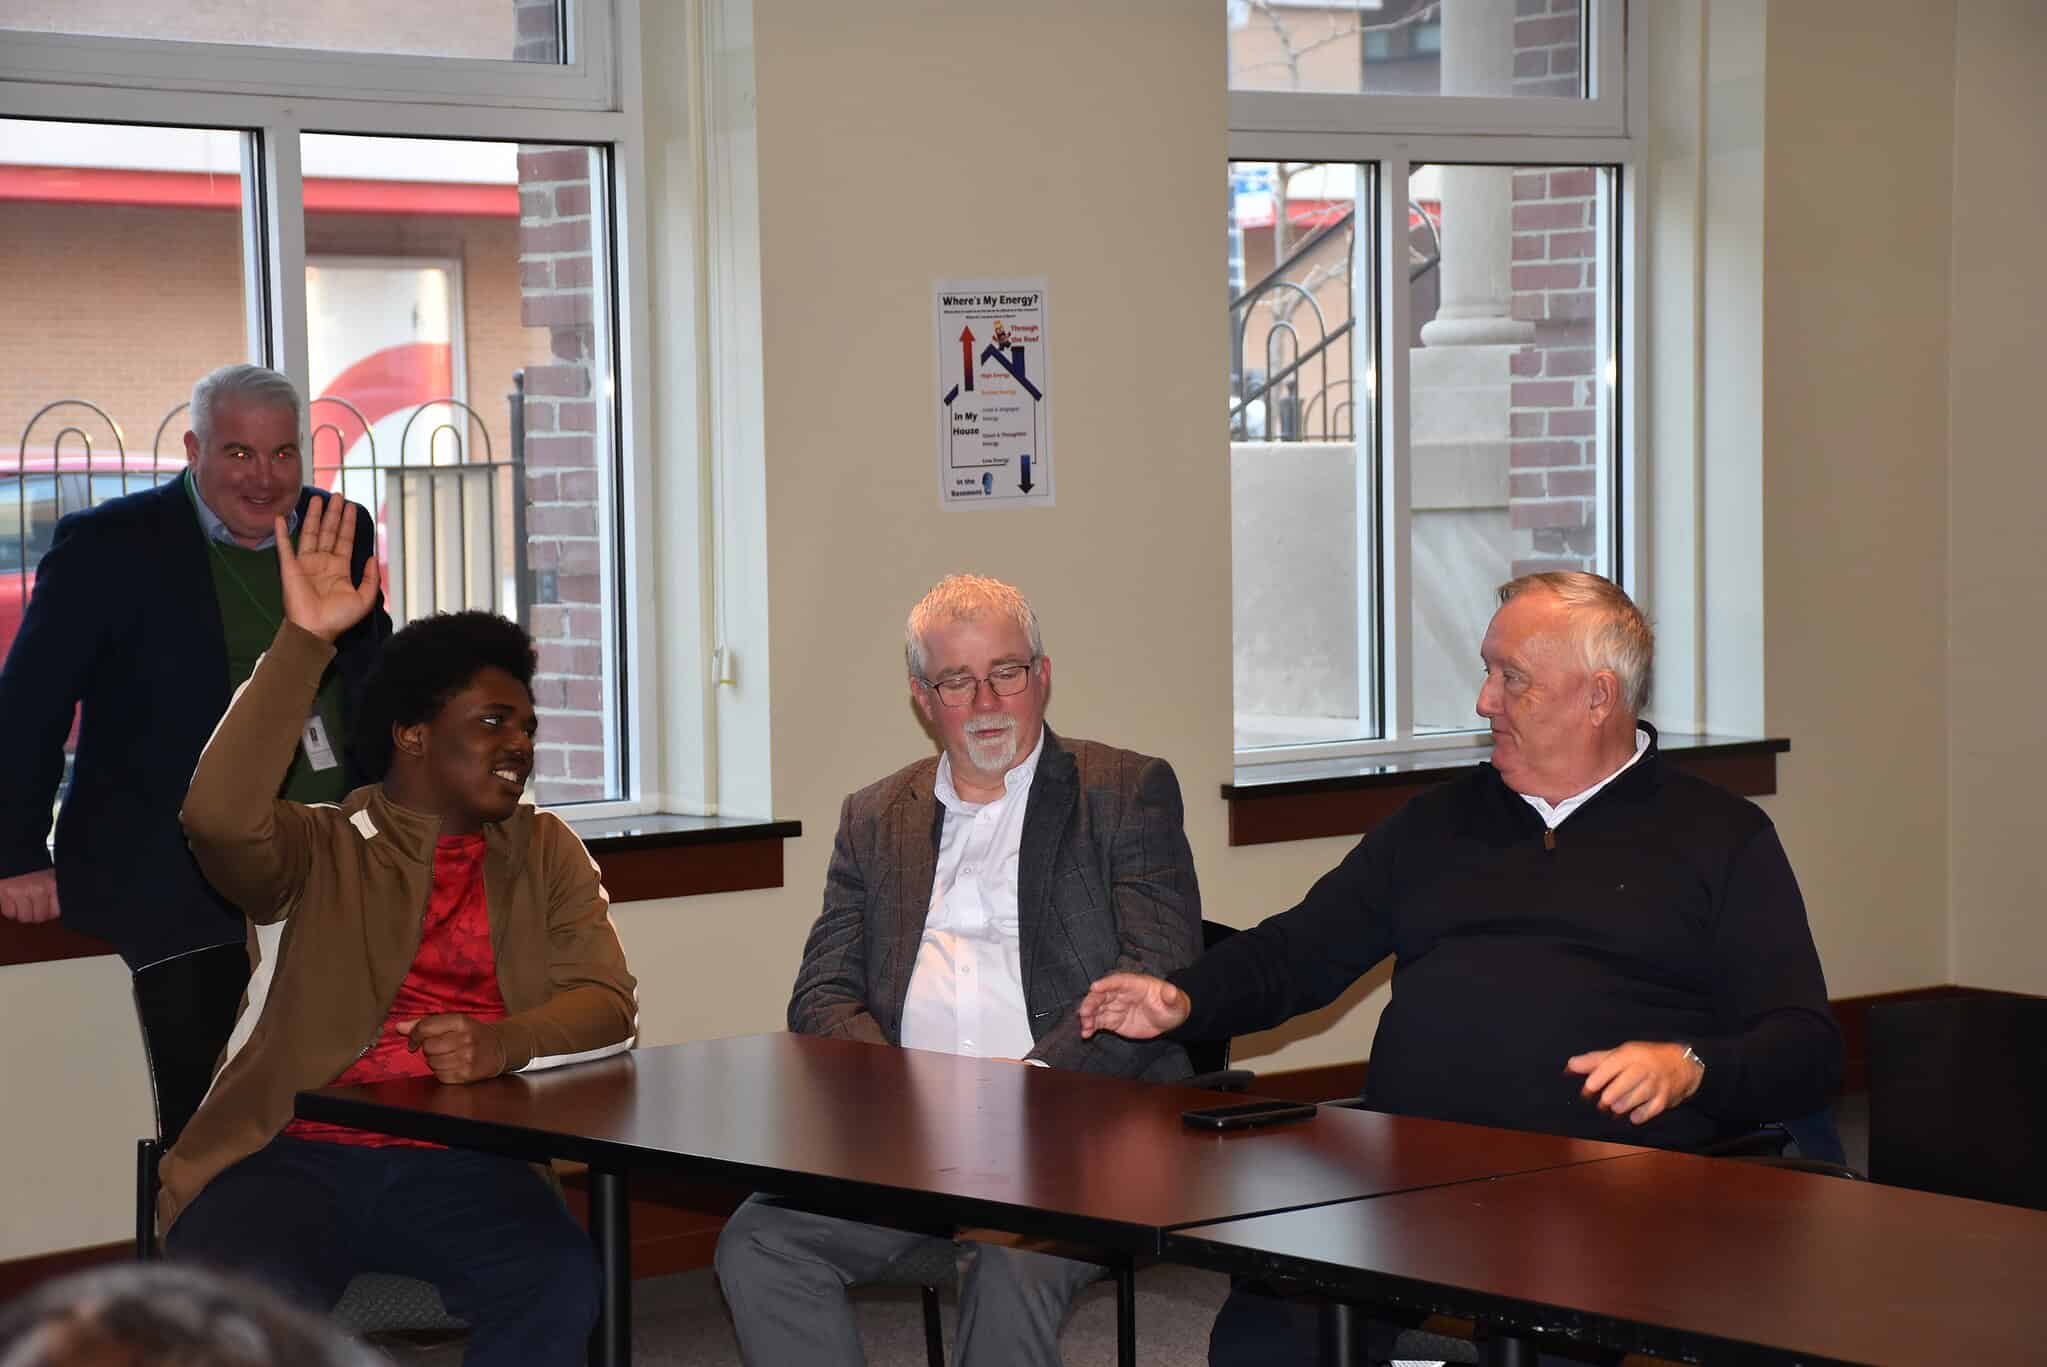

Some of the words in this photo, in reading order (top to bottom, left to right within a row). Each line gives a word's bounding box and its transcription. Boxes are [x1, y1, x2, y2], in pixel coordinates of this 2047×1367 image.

[942, 296, 981, 306] Where's
[983, 295, 998, 307] My
[999, 294, 1038, 306] Energy?
[954, 413, 963, 421] In
[965, 412, 978, 422] My
